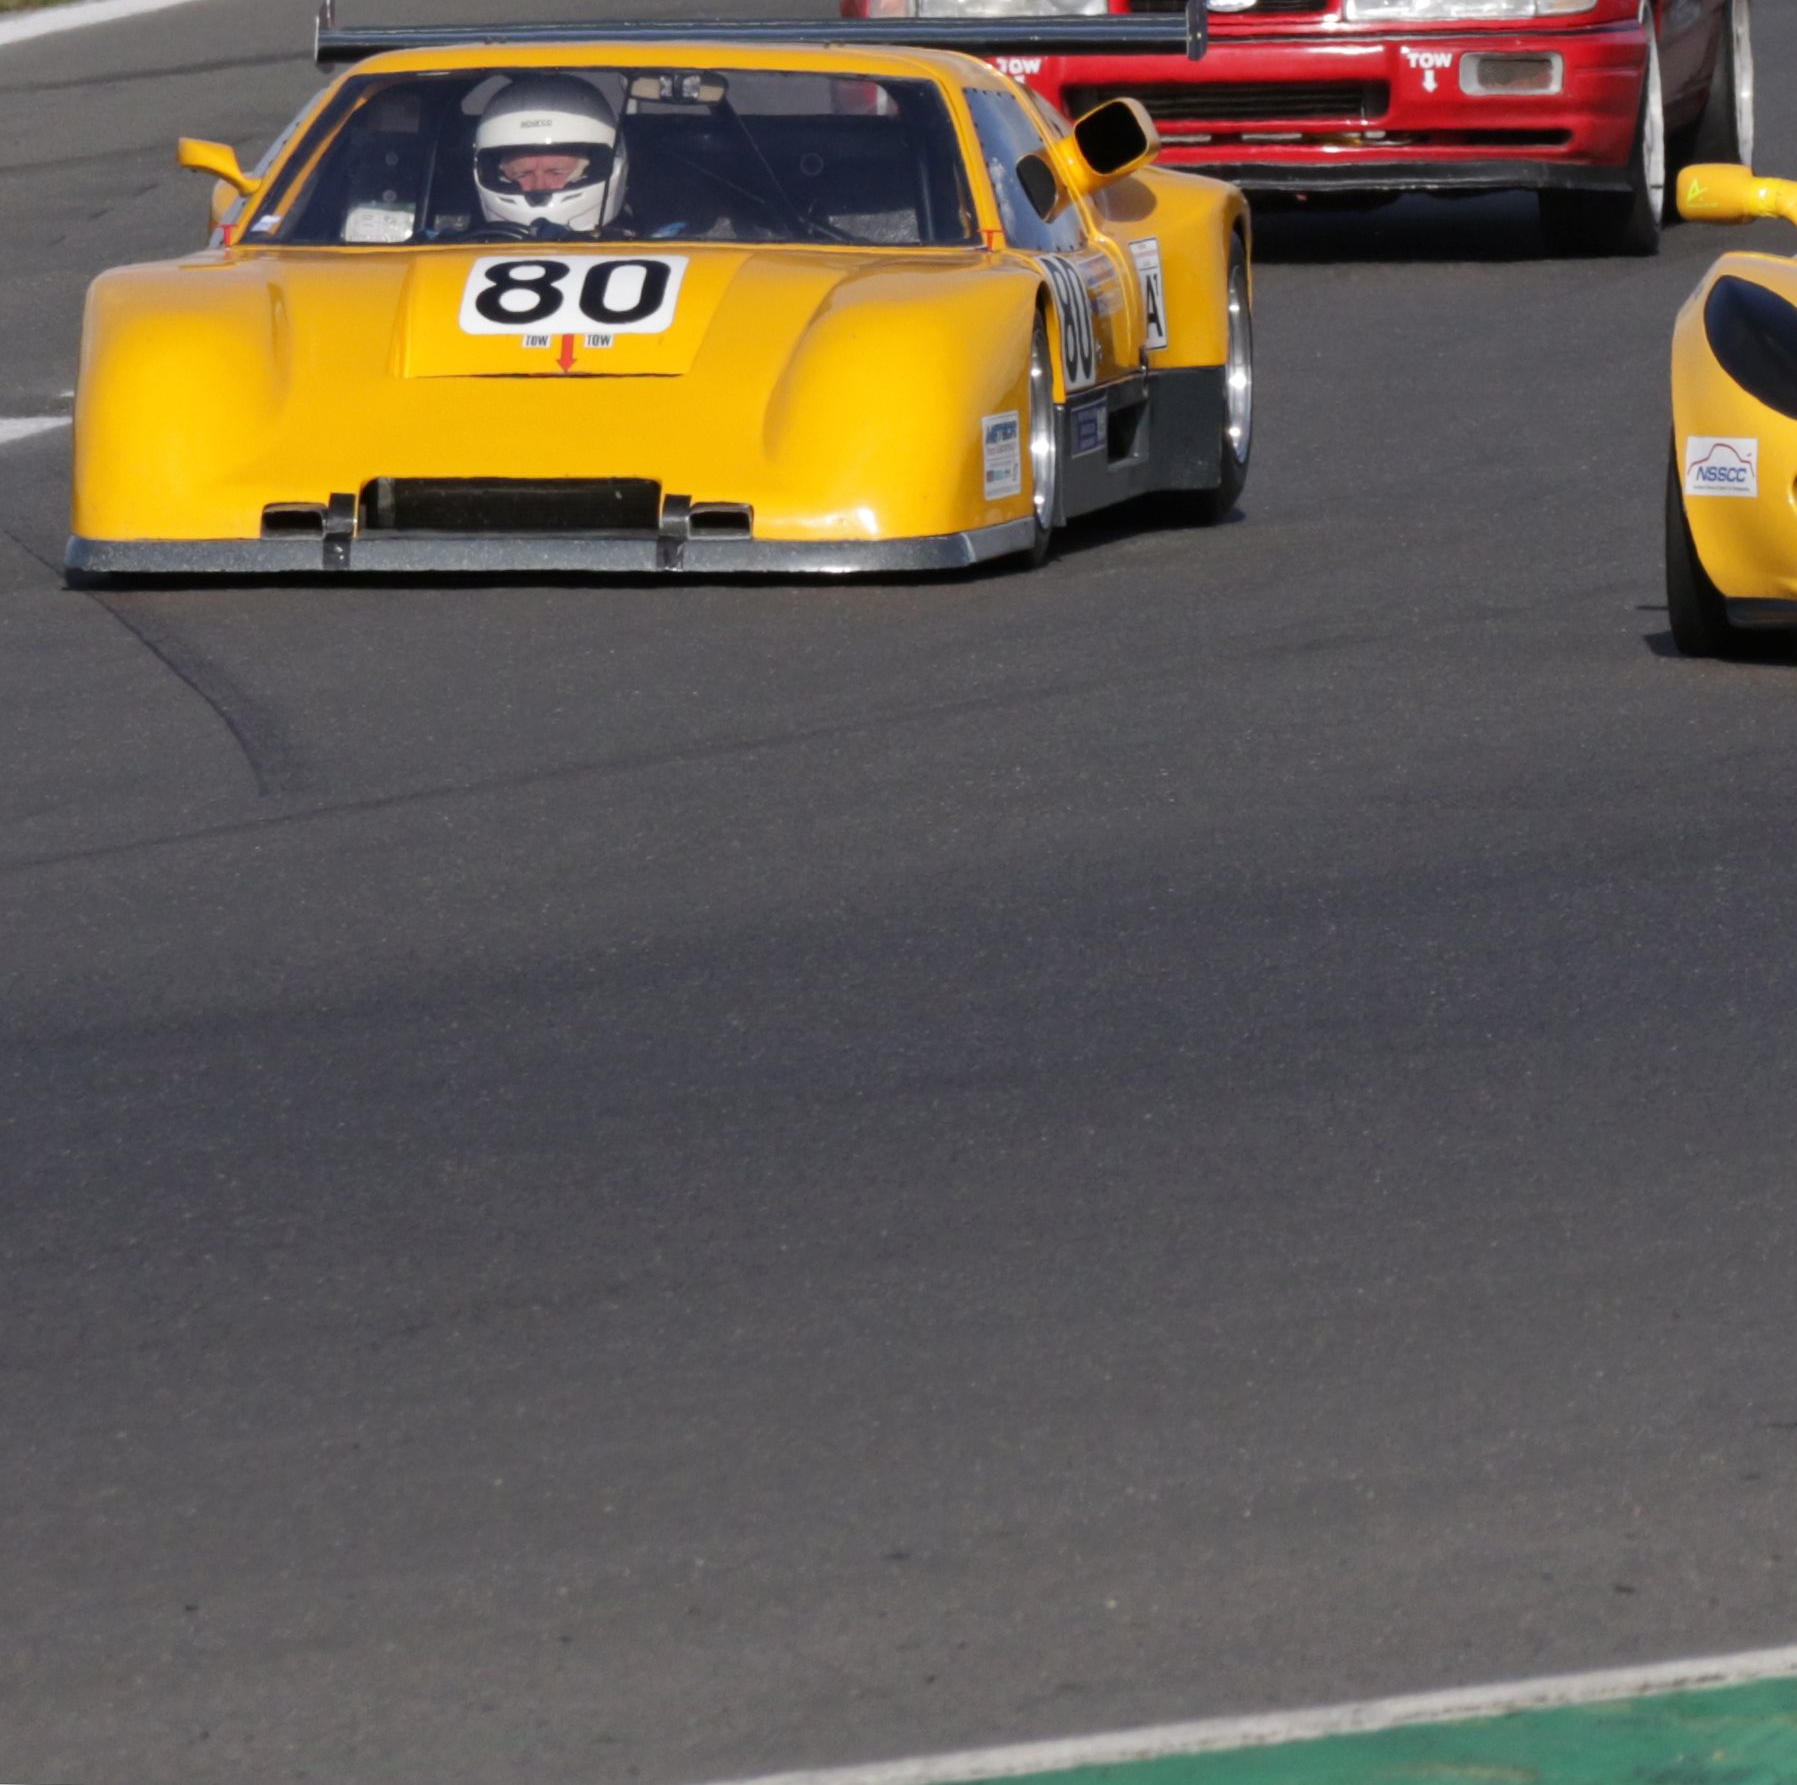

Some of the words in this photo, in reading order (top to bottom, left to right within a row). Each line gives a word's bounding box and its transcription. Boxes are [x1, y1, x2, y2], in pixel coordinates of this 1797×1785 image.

[1407, 52, 1453, 69] TOW
[475, 259, 672, 325] 80
[1039, 253, 1094, 385] 80
[525, 334, 549, 347] TOW
[586, 333, 613, 347] TOW
[1696, 465, 1748, 484] NSSCC
